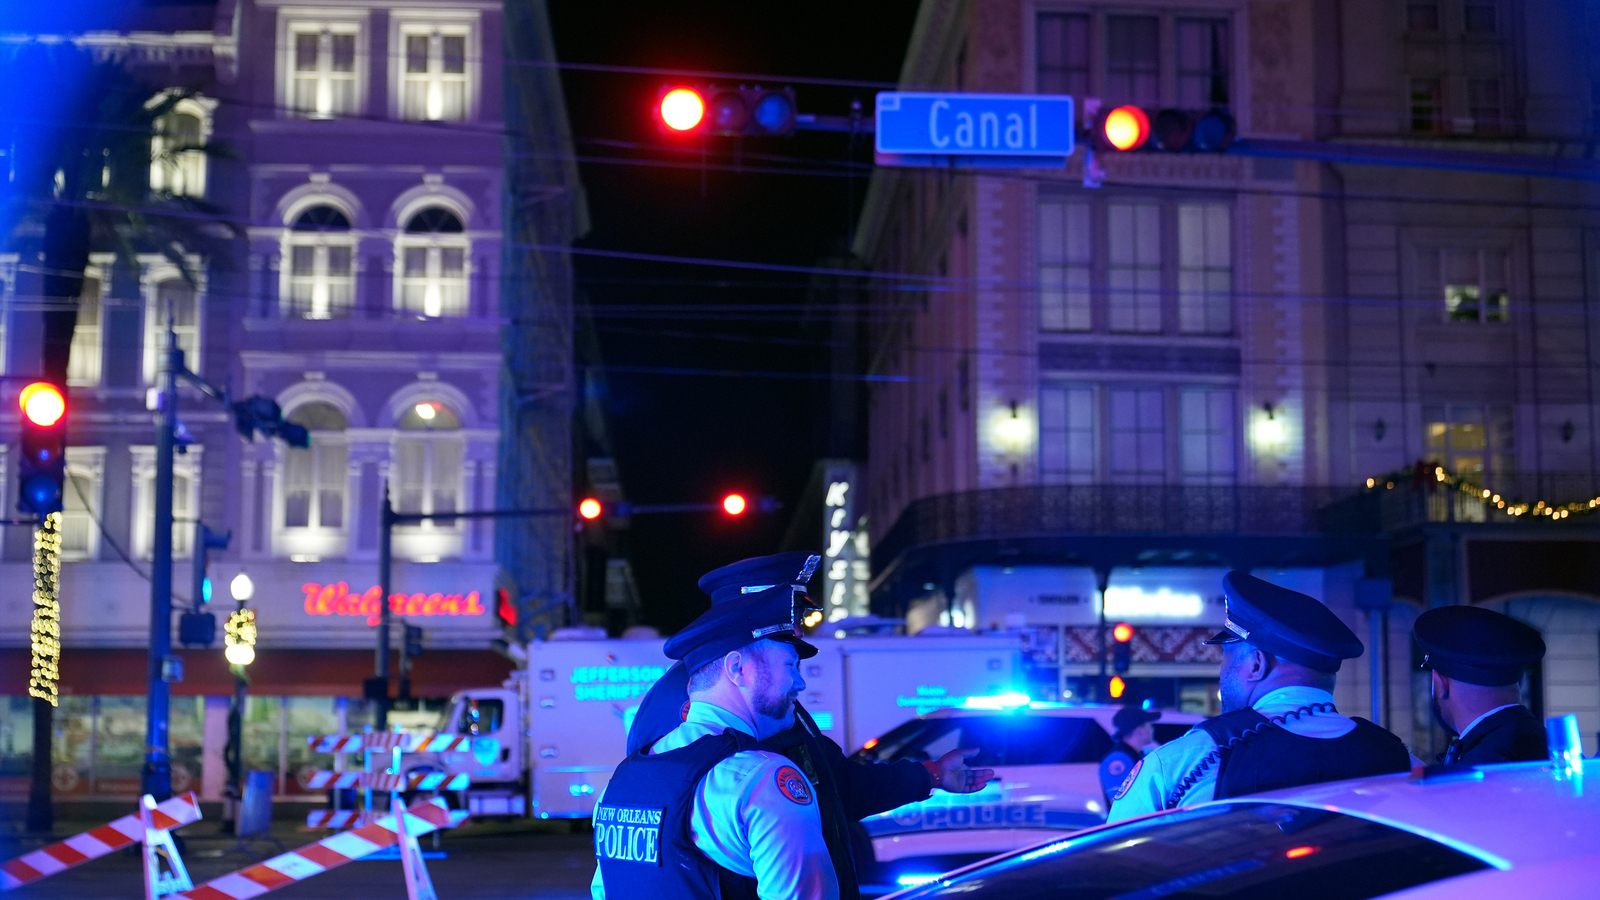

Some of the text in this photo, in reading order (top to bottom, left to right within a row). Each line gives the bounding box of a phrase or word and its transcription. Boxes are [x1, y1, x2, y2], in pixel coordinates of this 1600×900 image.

[929, 100, 1038, 149] Canal
[569, 665, 665, 684] JEFFERSON
[597, 806, 662, 825] NEW ORLEANS
[922, 804, 1044, 829] POLICE
[595, 822, 659, 863] POLICE
